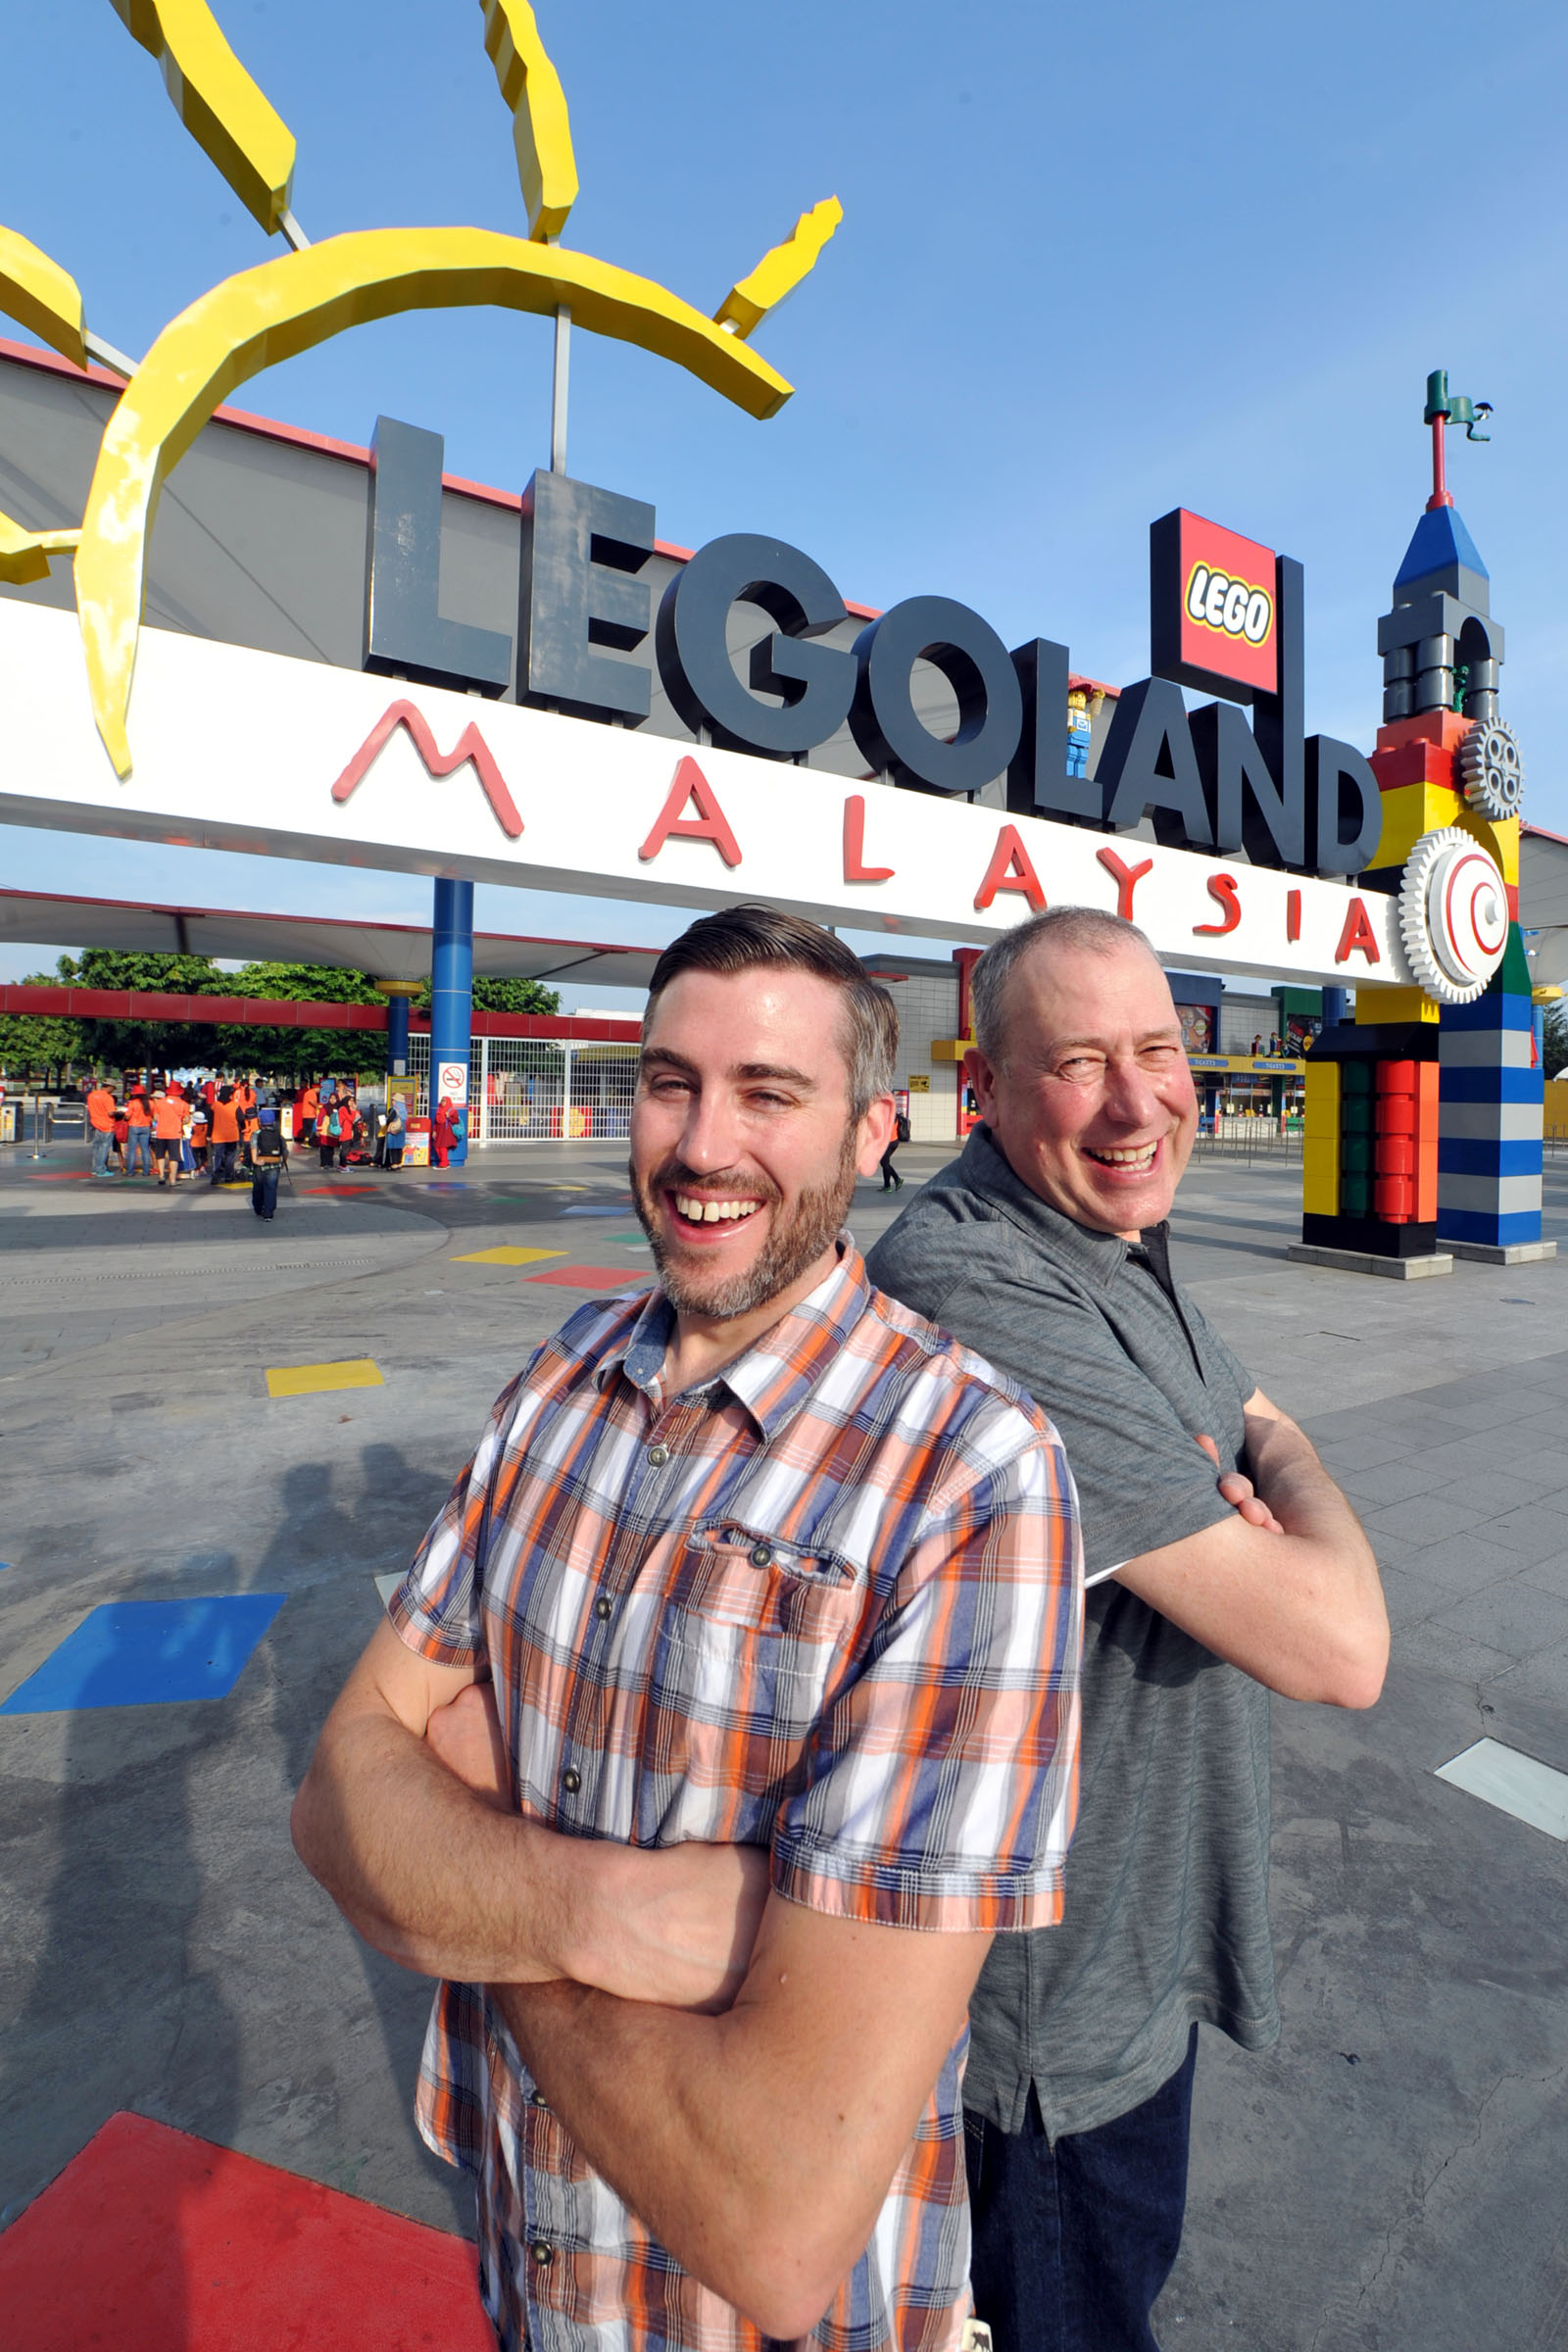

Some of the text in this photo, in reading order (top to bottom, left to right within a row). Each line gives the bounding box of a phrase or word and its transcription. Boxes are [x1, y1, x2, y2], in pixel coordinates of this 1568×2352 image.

[363, 415, 1384, 876] LEGOLAND
[1188, 564, 1270, 644] LEGO
[330, 698, 1381, 964] MALAYSIA
